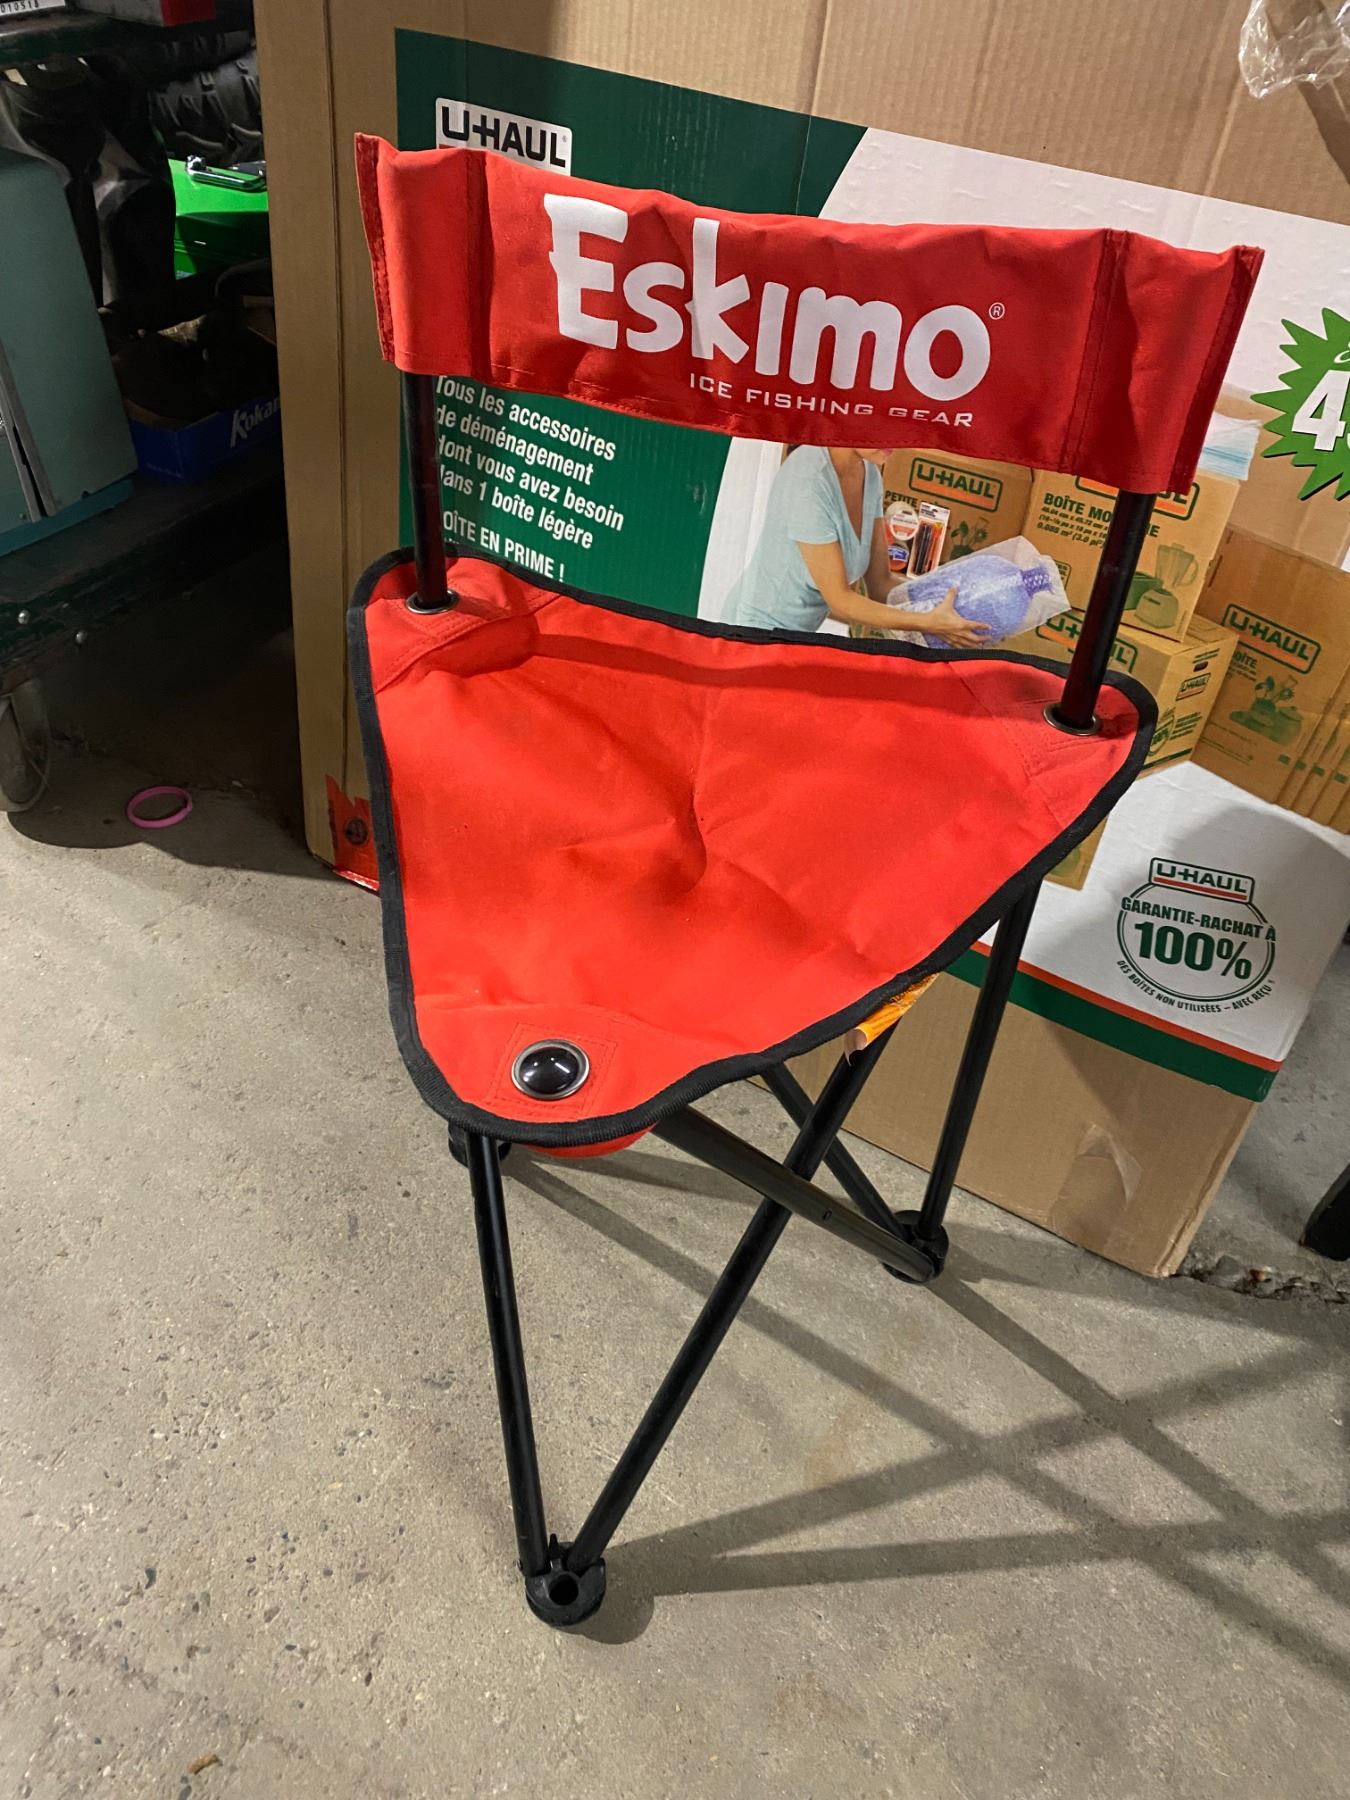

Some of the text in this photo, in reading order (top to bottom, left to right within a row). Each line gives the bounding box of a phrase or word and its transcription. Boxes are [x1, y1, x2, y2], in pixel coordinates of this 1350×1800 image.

[441, 105, 566, 168] U-HAUL
[543, 193, 990, 401] Eskimo
[436, 375, 617, 461] Tous les accessoires
[690, 372, 973, 427] ICE FISHING GEAR
[1291, 369, 1350, 452] 4
[436, 404, 595, 485] de déménagement
[440, 464, 593, 549] ans 1 boîte légère
[477, 453, 515, 483] vous
[519, 472, 560, 503] avez
[563, 487, 624, 531] besoin
[916, 464, 995, 499] U-HAUL
[1043, 492, 1085, 515] BOÎTE
[443, 510, 476, 542] OÎTE
[480, 526, 500, 553] EN
[504, 537, 554, 579] PRIME
[1229, 611, 1309, 661] U-HAUL
[1156, 863, 1247, 893] U-HAUL
[1121, 896, 1277, 942] GARANTIE-RACHAT À
[1134, 921, 1252, 980] 100%
[1117, 960, 1131, 974] DES
[1155, 993, 1175, 1006] NON
[1231, 996, 1254, 1010] AVEC
